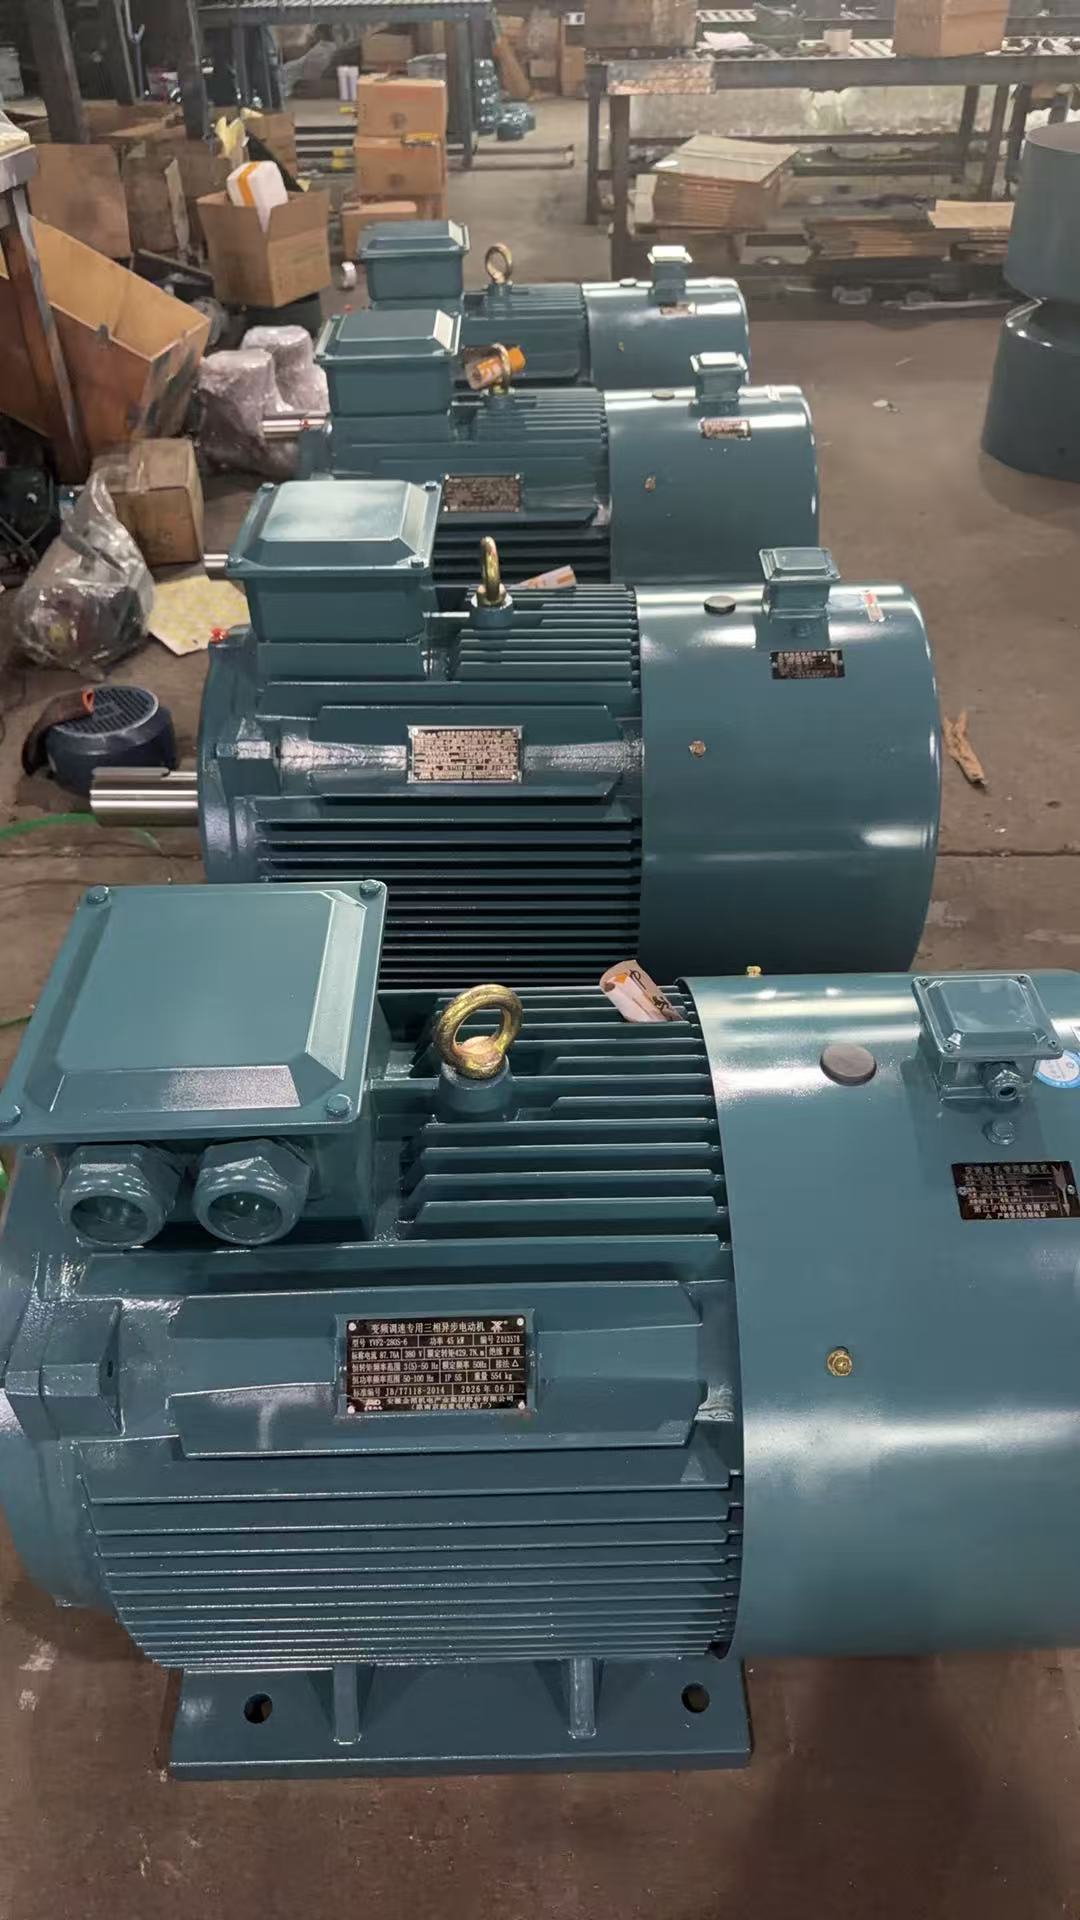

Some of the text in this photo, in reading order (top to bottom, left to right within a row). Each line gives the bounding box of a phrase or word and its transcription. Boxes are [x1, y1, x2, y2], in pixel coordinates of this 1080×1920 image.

[371, 1321, 485, 1334] 变频调速专用三相异步电动机
[352, 1338, 366, 1348] 型号
[429, 1336, 443, 1346] 功率
[480, 1335, 493, 1345] 编号
[404, 1350, 416, 1358] 380
[402, 1374, 424, 1383] 50-100
[444, 1373, 452, 1382] IP
[474, 1372, 488, 1381] 重量
[504, 1372, 513, 1381] kg
[460, 1385, 481, 1393] 2026
